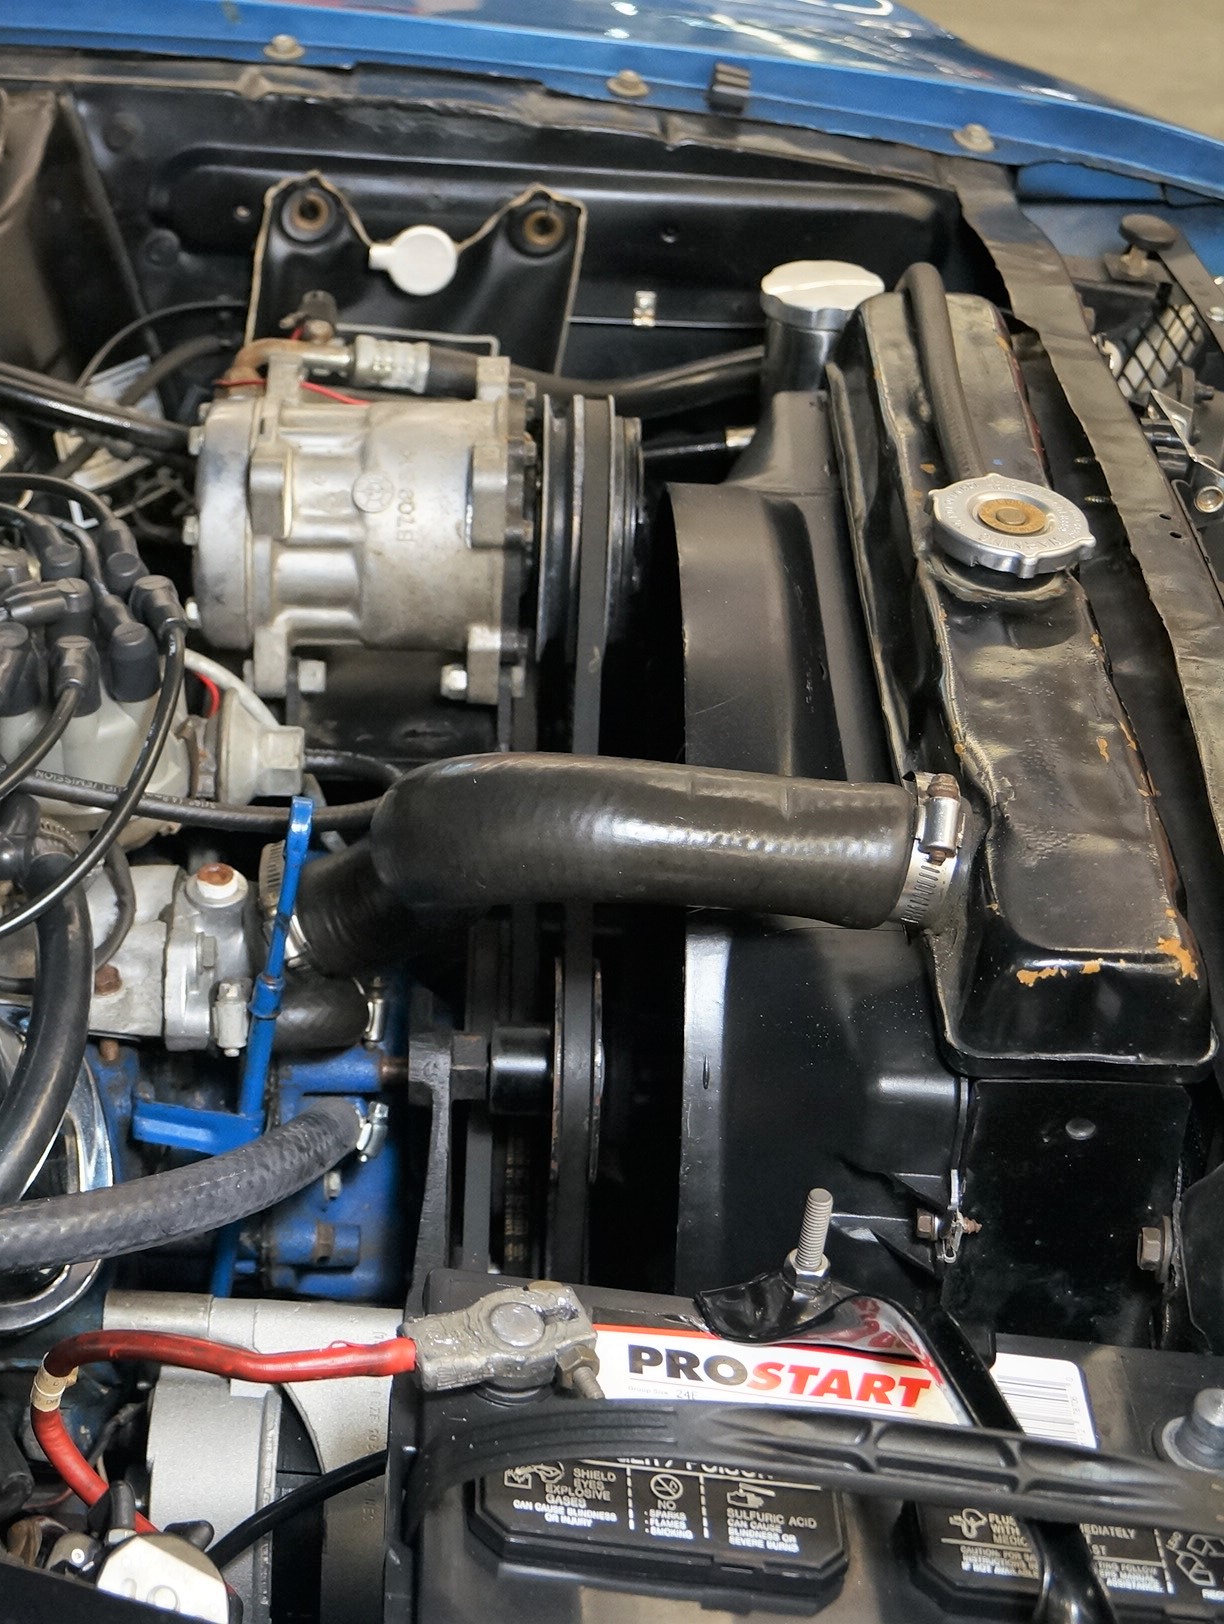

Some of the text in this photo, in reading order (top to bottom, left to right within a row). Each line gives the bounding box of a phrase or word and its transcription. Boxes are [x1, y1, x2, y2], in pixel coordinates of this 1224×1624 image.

[628, 1344, 931, 1408] PROSTART
[573, 1468, 616, 1482] SHIELD
[574, 1478, 604, 1491] EYES
[545, 1484, 612, 1502] EXPLOSIVE
[546, 1494, 586, 1508] GASES
[657, 1499, 676, 1511] NO
[512, 1499, 618, 1522] CAN CAUSE BLINDNESS
[544, 1513, 594, 1528] OR INJURY
[649, 1518, 687, 1530] FLAMES
[726, 1508, 818, 1529] SULFURIC ACID
[988, 1512, 1016, 1526] FLUS
[727, 1518, 782, 1534] CAN CAUSE
[650, 1528, 694, 1540] SMOKING
[728, 1528, 796, 1543] BLINDNESS OR
[992, 1534, 1028, 1547] MEDIC
[728, 1536, 800, 1554] SEVERE BURNS
